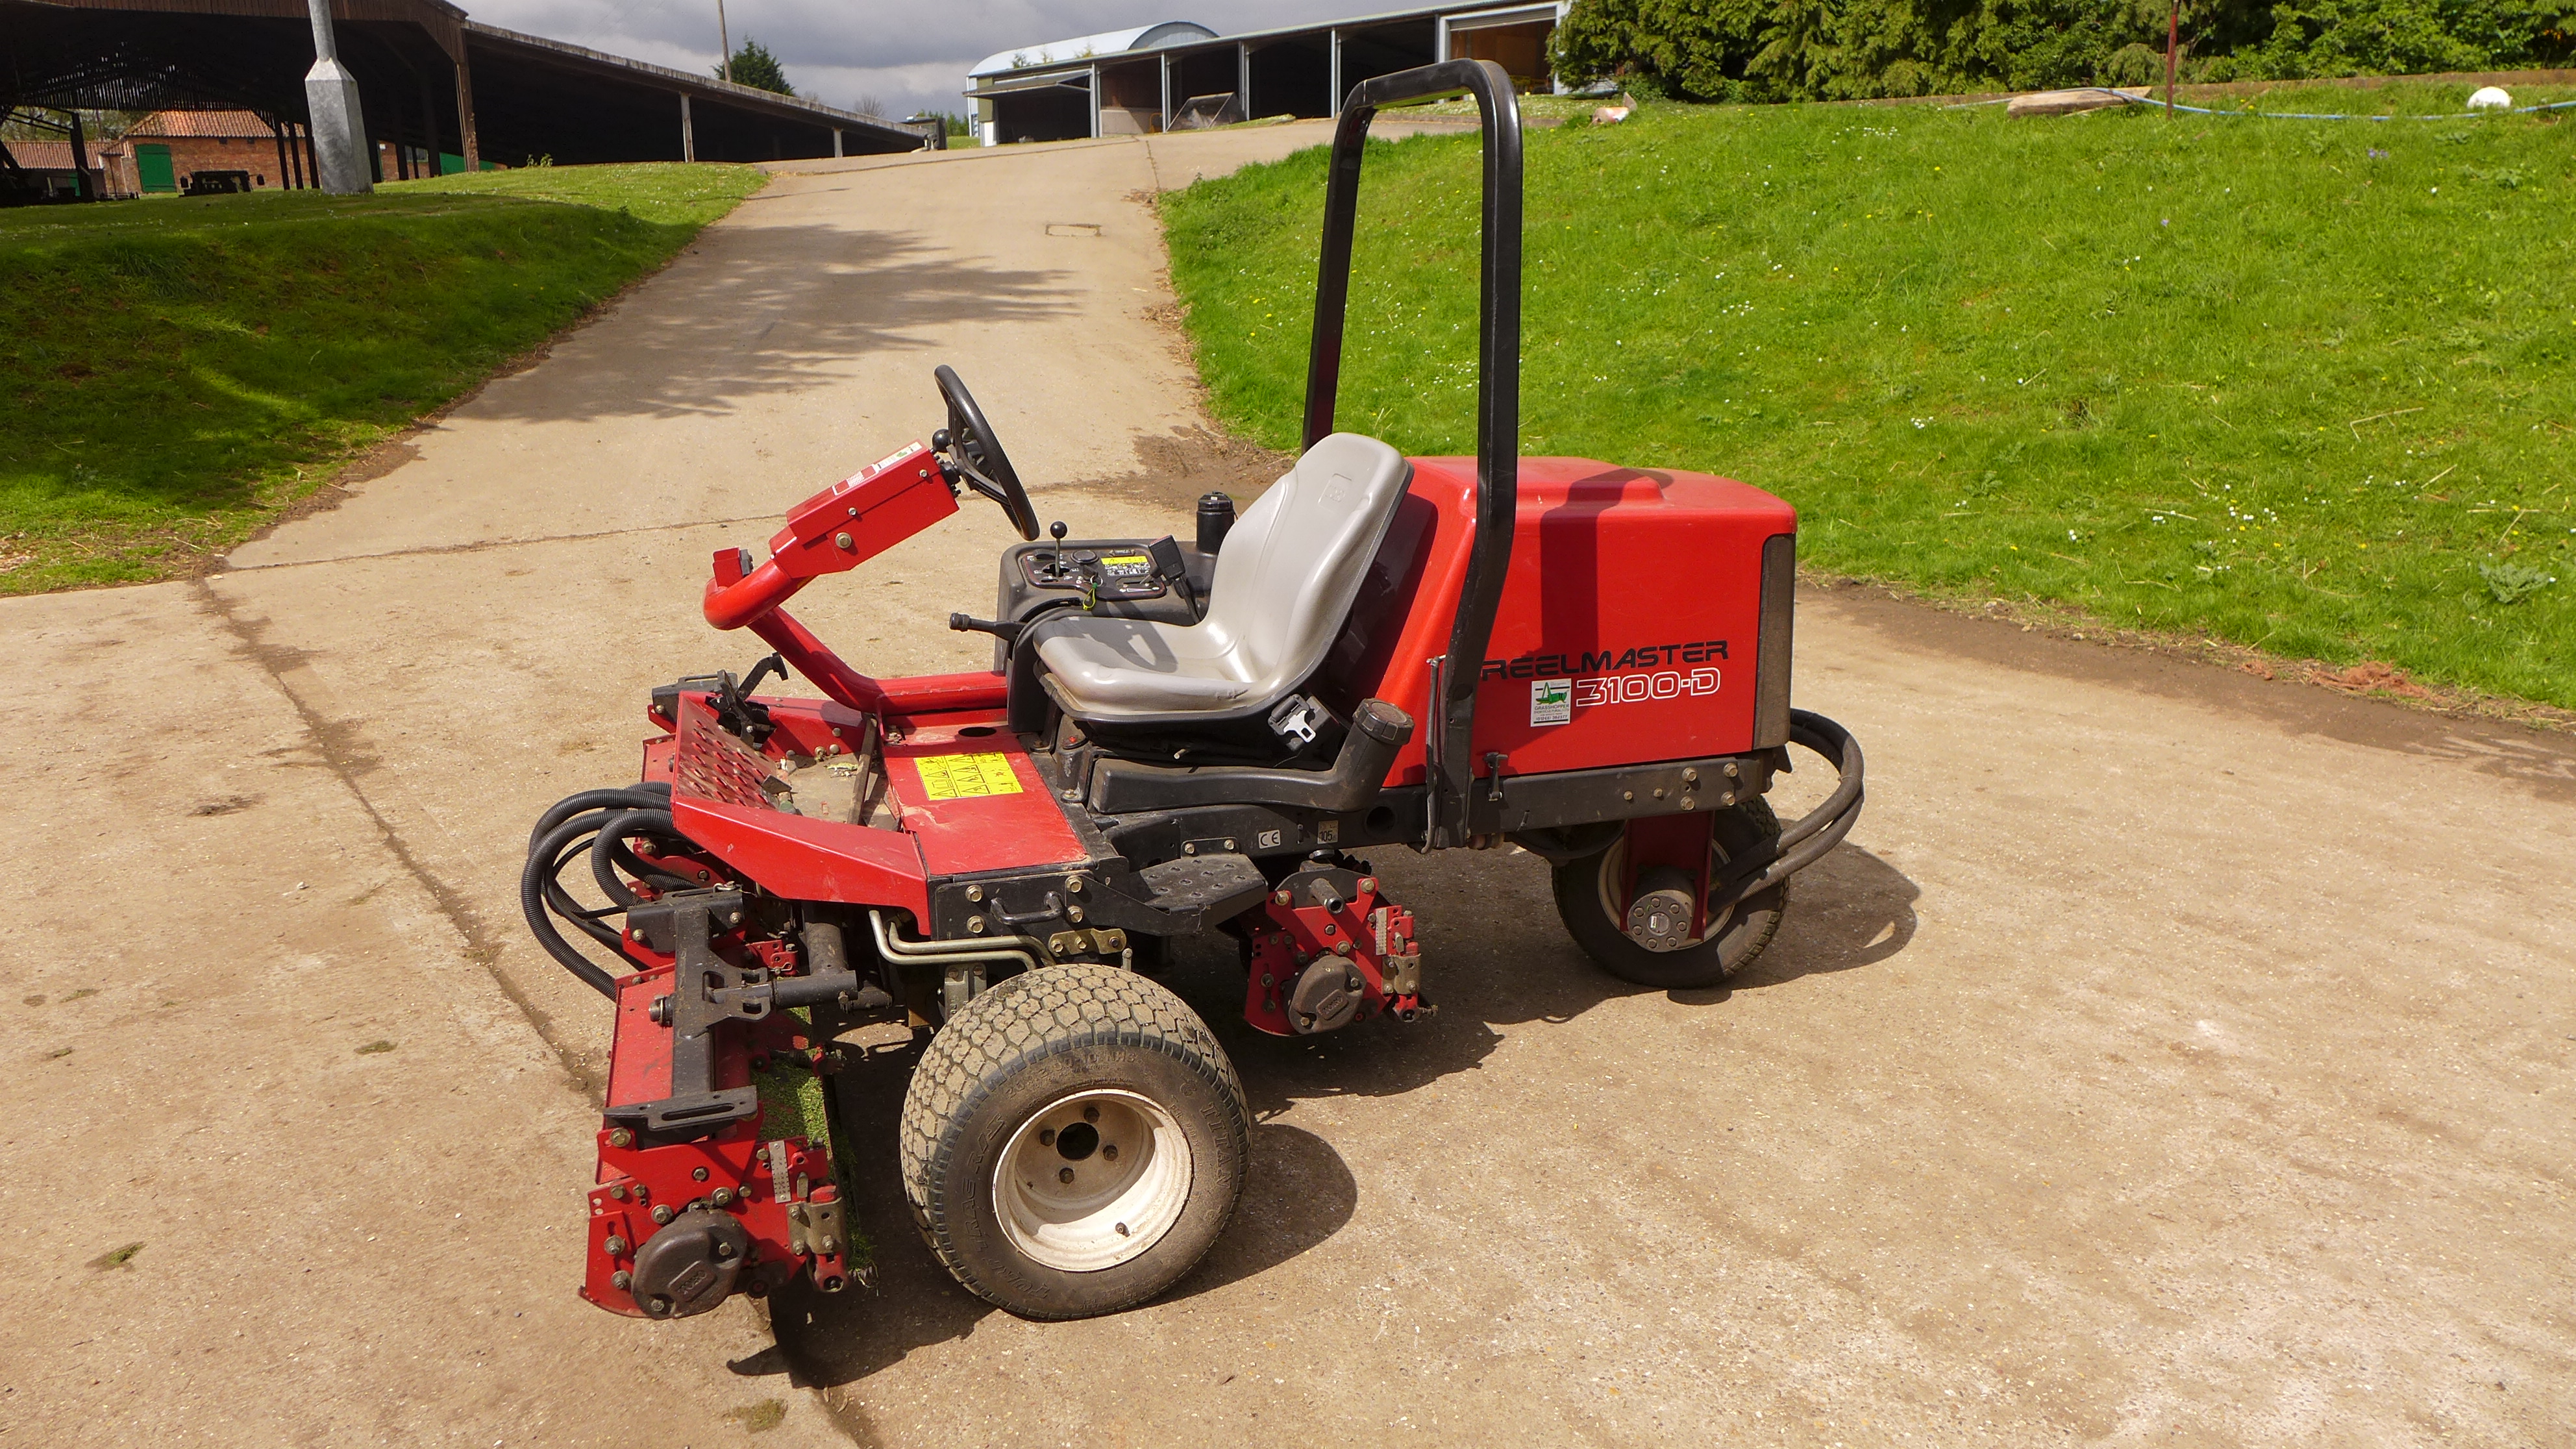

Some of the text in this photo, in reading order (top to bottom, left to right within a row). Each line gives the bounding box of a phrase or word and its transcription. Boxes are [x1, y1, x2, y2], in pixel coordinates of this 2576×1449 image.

[1481, 639, 1729, 682] REELMASTER
[1576, 667, 1722, 708] 3100-D
[1259, 831, 1280, 847] CE
[1319, 830, 1333, 841] 105
[1200, 1101, 1233, 1190] TITAN
[961, 1176, 989, 1252] TRAC
